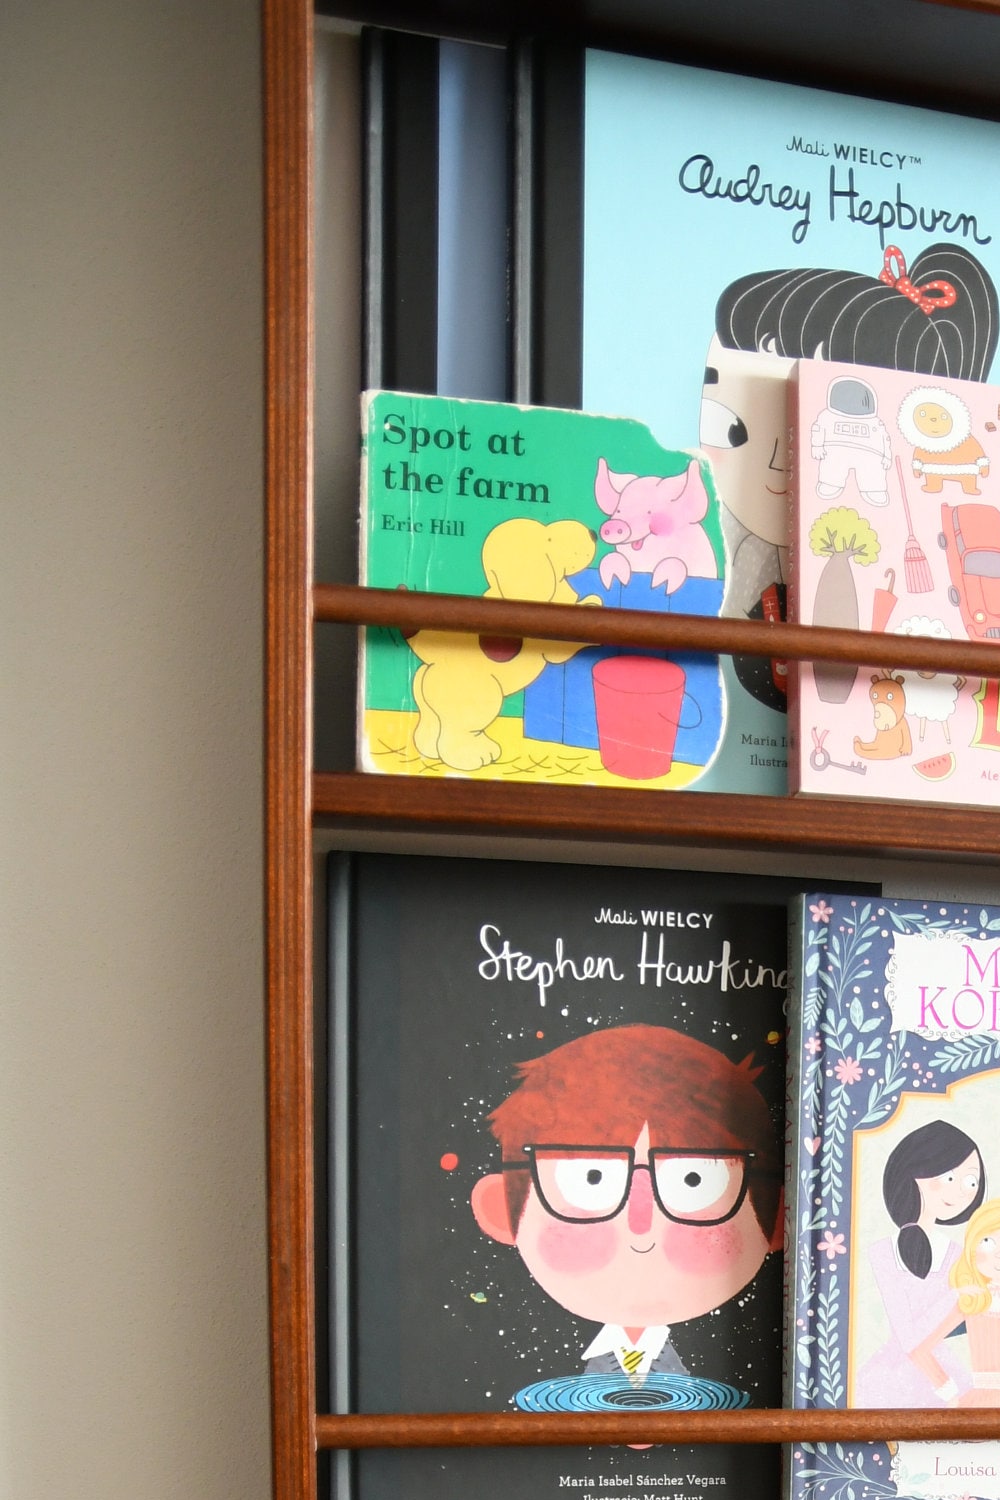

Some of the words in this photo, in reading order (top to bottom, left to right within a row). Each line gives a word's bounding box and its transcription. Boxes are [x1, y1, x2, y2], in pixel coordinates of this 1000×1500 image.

[786, 135, 830, 158] Mali
[678, 153, 811, 244] Audrey
[828, 165, 992, 249] Hepburn
[382, 413, 473, 455] Spot
[487, 428, 527, 457] at
[382, 461, 445, 494] the
[456, 467, 551, 504] farm
[381, 513, 424, 534] Eric
[429, 518, 466, 538] Hill
[741, 733, 777, 747] Maria
[594, 907, 638, 926] Mali
[641, 911, 713, 929] WIELCY
[478, 923, 624, 1007] Stephen
[934, 1457, 996, 1478] Louisa
[559, 1475, 595, 1488] Maria
[599, 1474, 634, 1487] Isabel
[636, 1473, 682, 1487] Sánchez
[683, 1475, 727, 1491] Vegara
